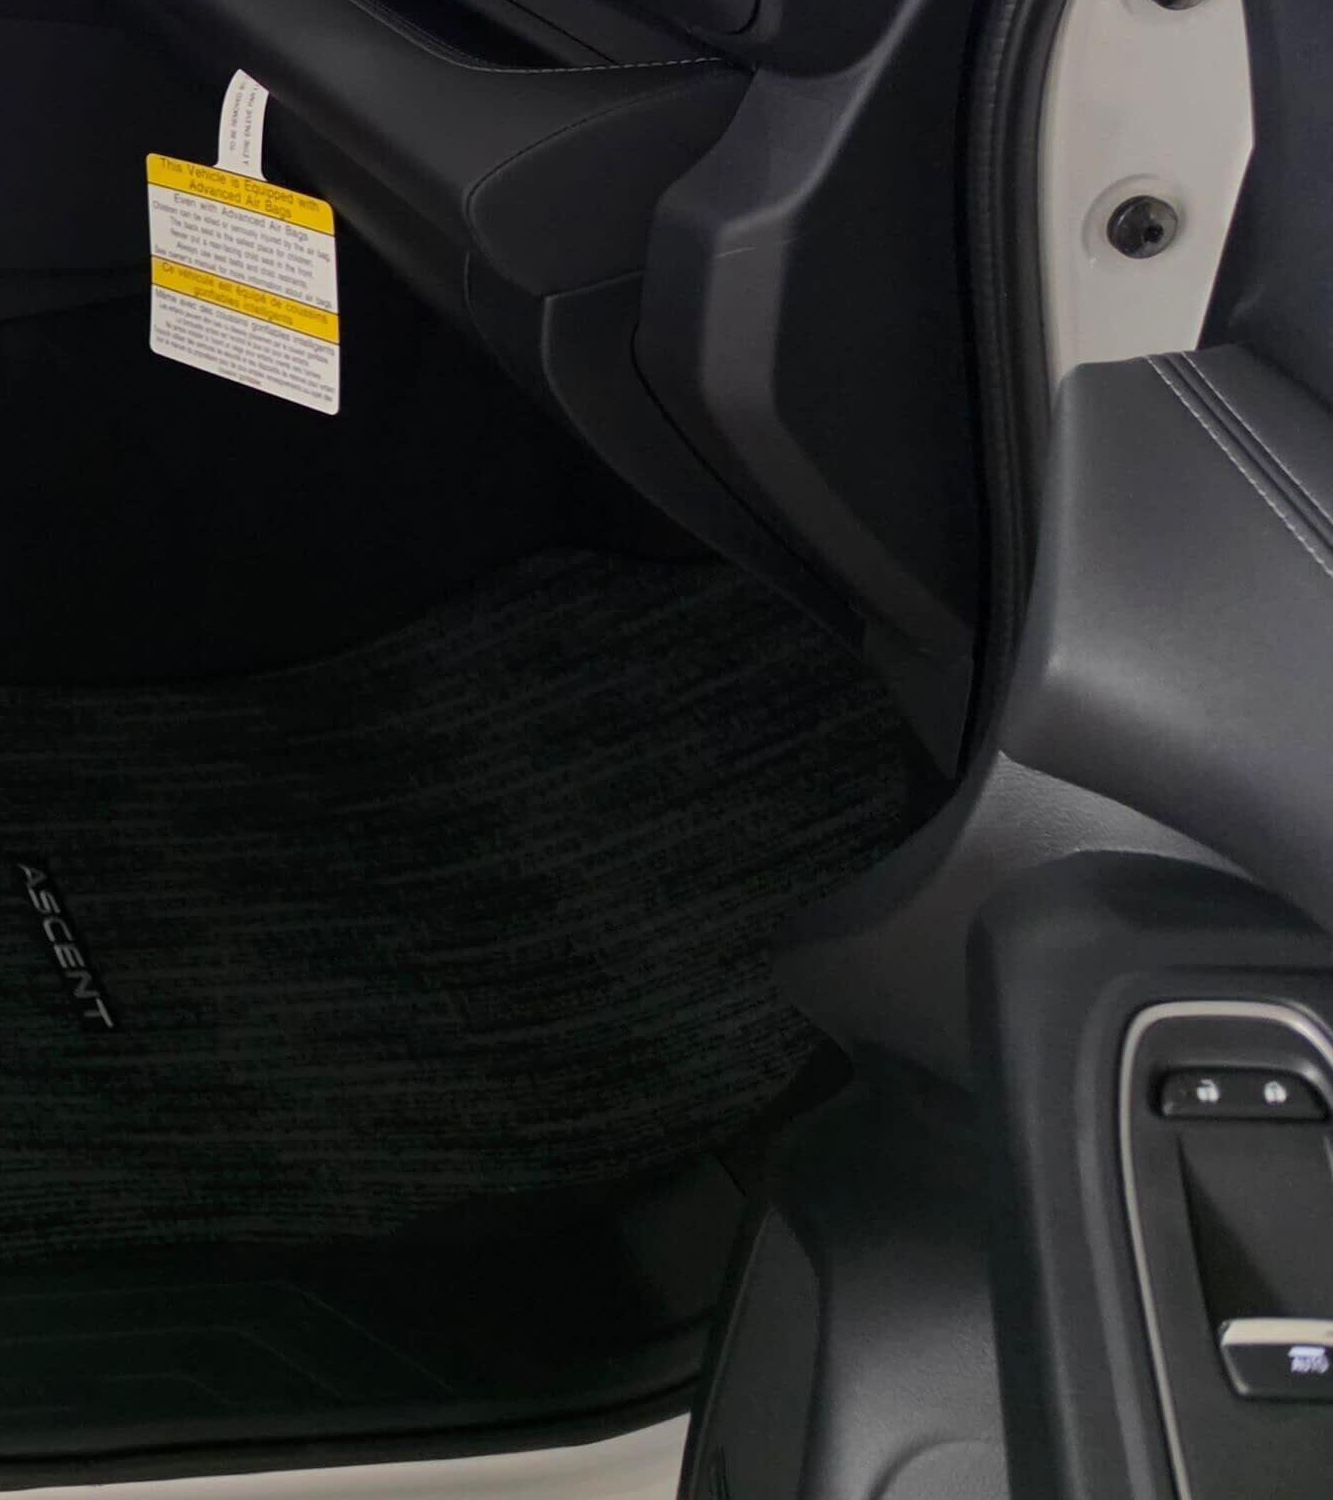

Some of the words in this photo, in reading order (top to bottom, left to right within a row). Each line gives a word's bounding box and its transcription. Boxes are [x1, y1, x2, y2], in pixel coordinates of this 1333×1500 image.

[160, 157, 182, 172] This
[187, 164, 225, 184] Vehicle
[245, 180, 293, 205] Equipped
[298, 197, 319, 213] with
[189, 179, 240, 203] Advanced
[245, 194, 260, 208] Air
[264, 199, 291, 221] Bags
[173, 192, 195, 208] Even
[221, 207, 265, 228] Advanced
[269, 220, 281, 232] Air
[285, 225, 308, 242] Bags
[17, 863, 114, 1028] ASCENT
